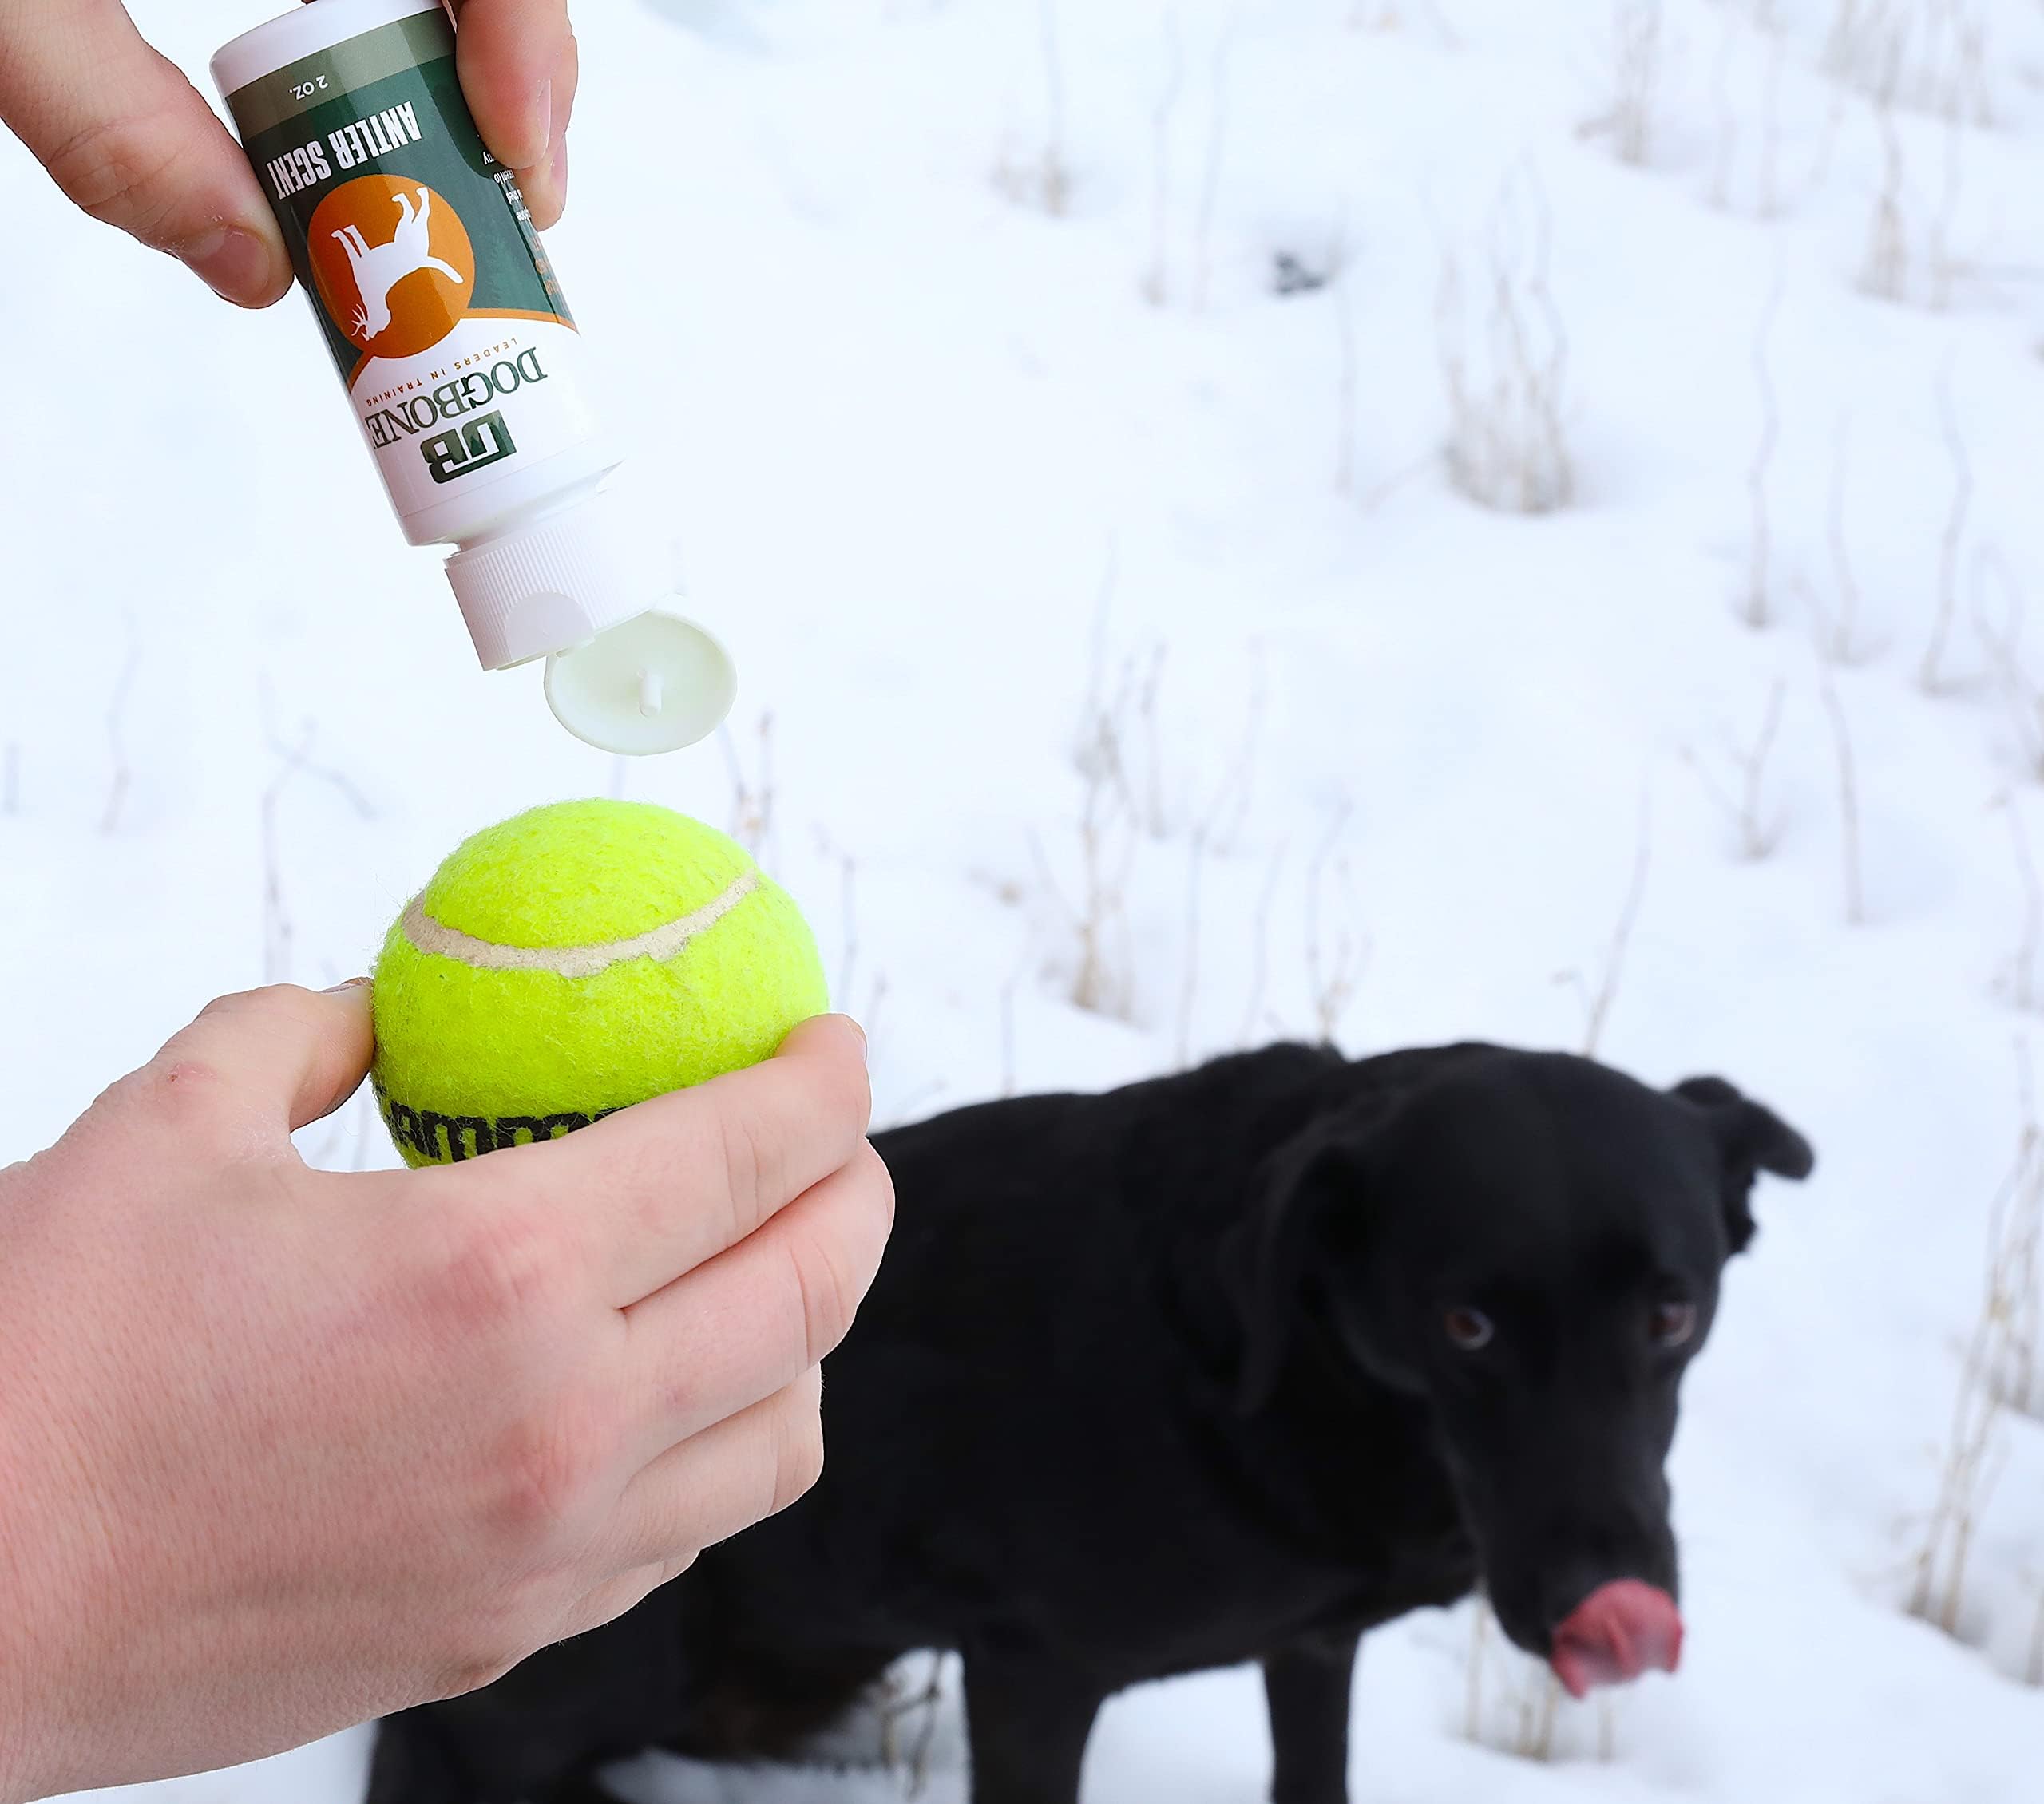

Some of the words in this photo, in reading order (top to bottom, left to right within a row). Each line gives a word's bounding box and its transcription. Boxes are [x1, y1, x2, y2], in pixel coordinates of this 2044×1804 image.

[288, 81, 315, 101] OZ.
[315, 74, 329, 89] 2
[327, 101, 422, 170] ANTLER
[266, 140, 332, 200] SCENT
[454, 337, 518, 370] LEADERS
[430, 367, 446, 380] IN
[364, 346, 549, 450] DOGBONE
[365, 378, 423, 407] TRAINING
